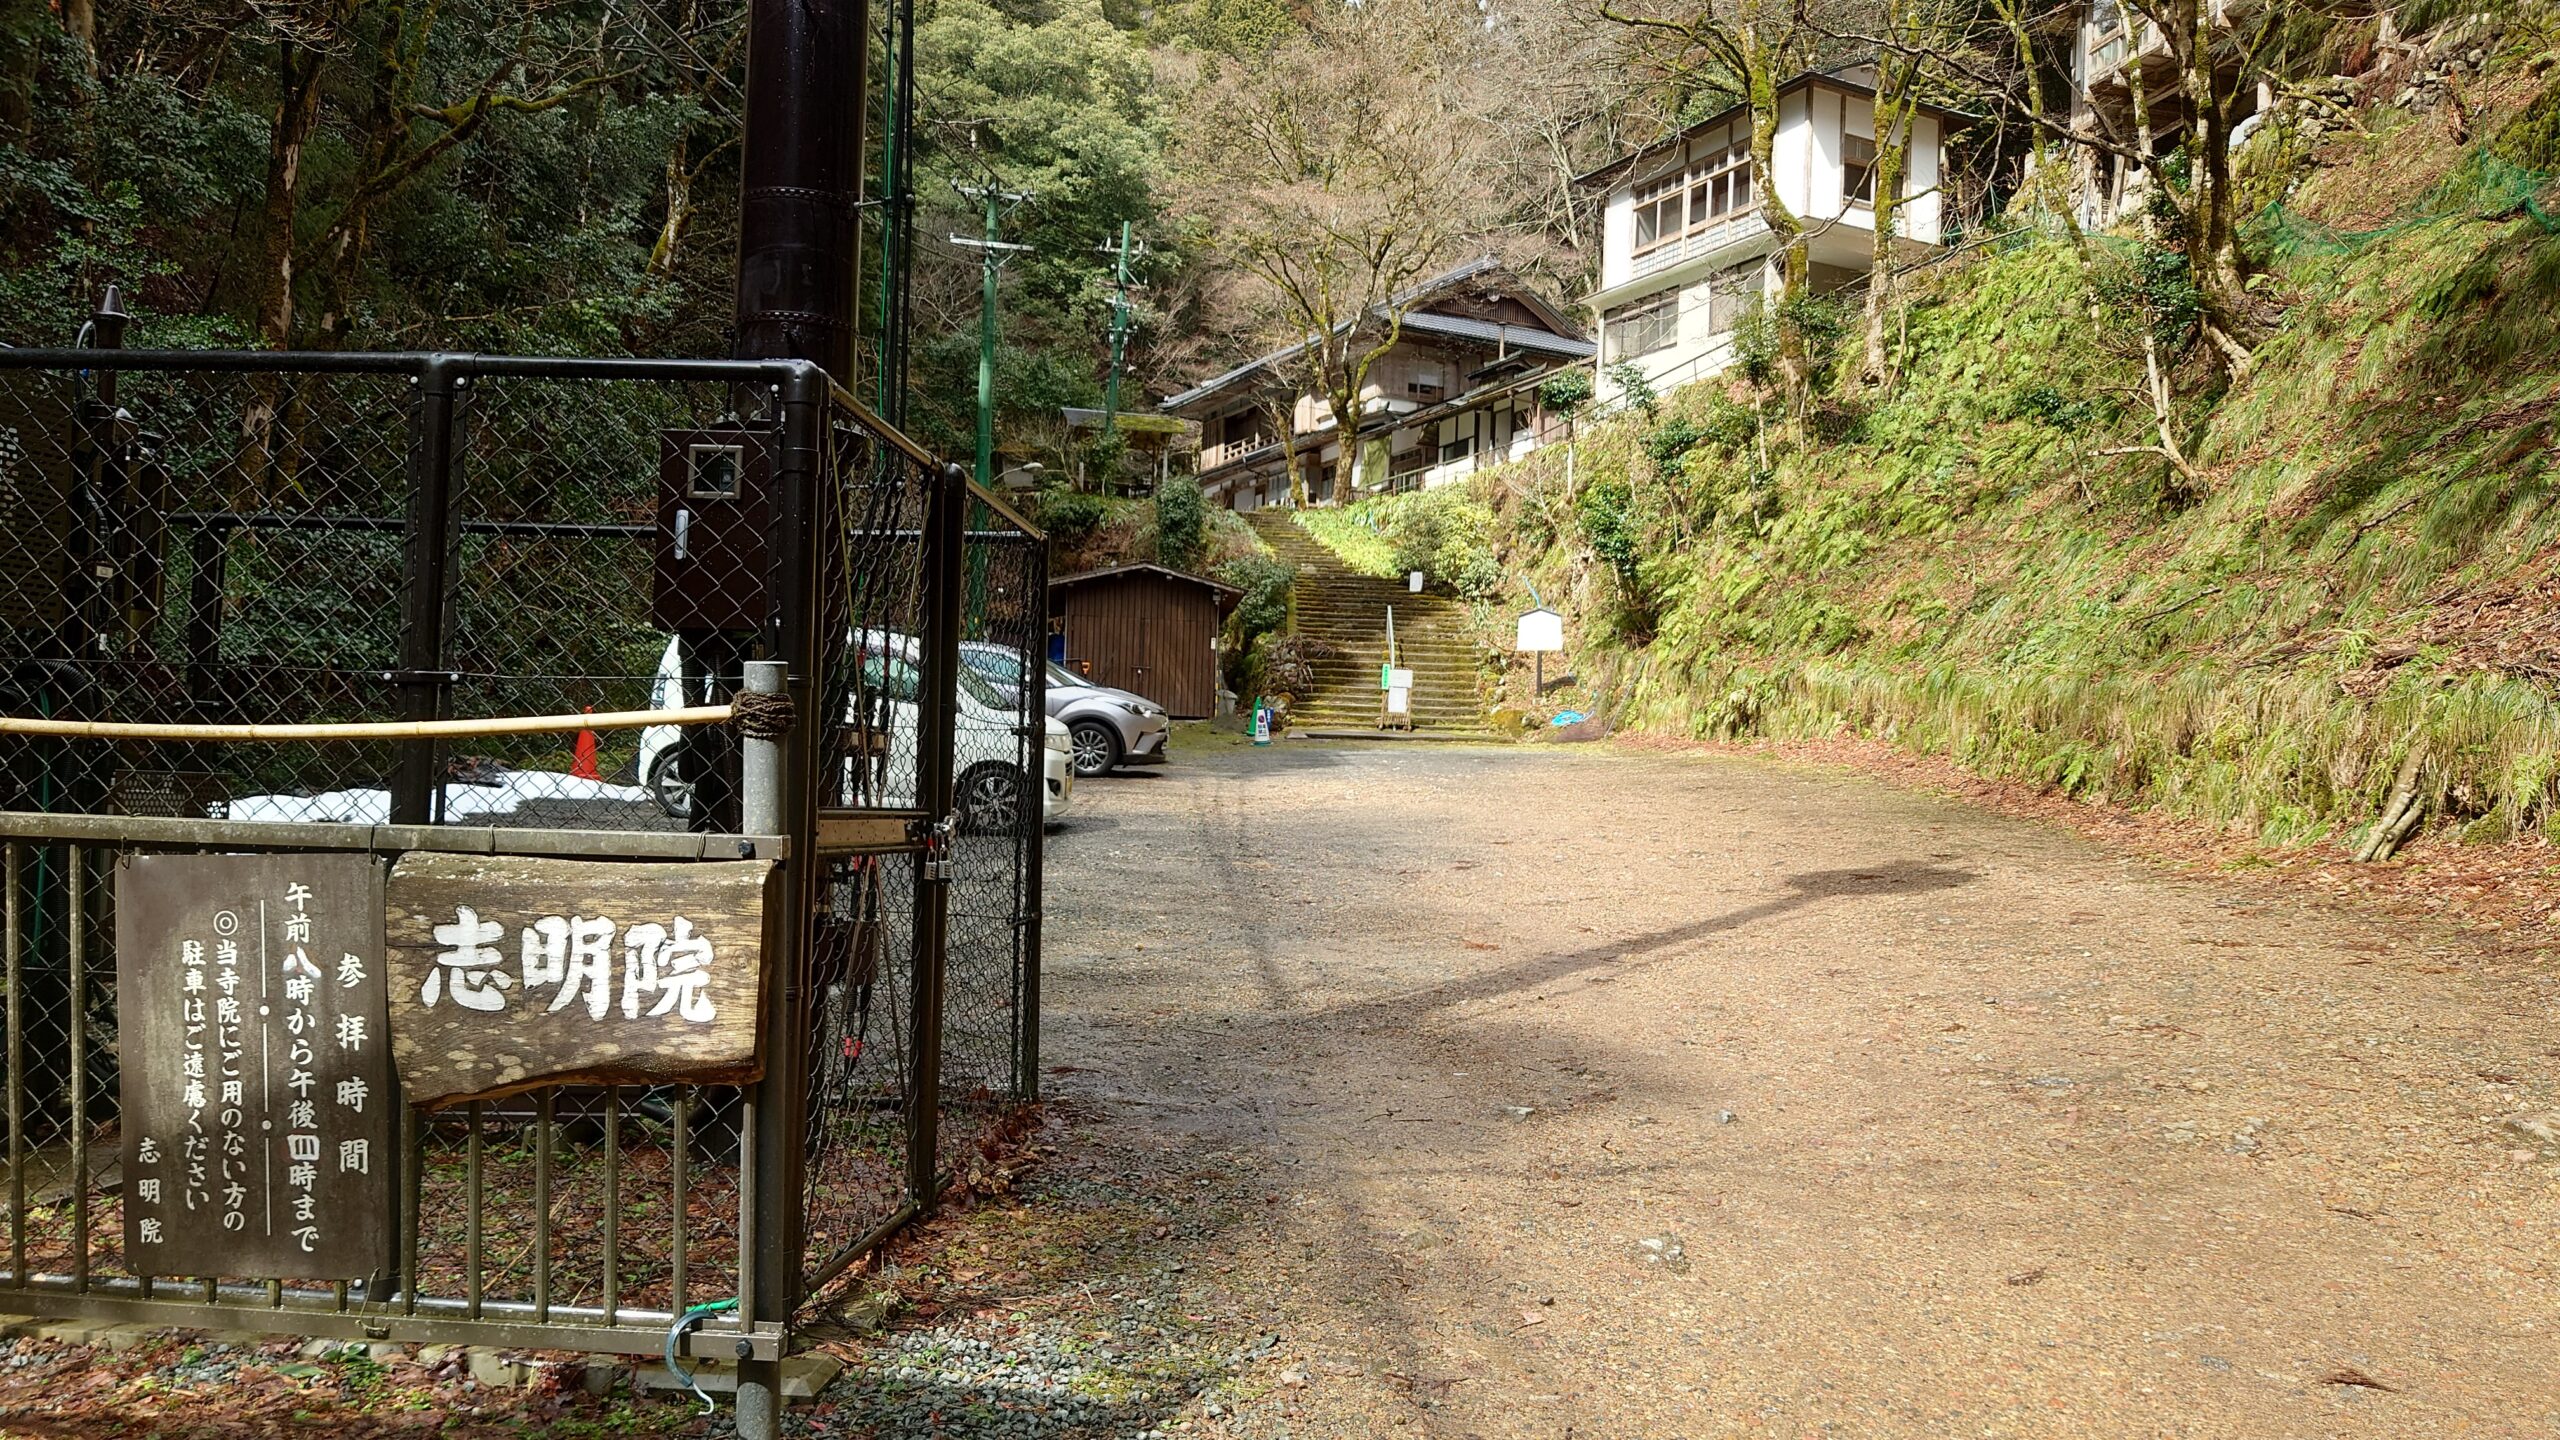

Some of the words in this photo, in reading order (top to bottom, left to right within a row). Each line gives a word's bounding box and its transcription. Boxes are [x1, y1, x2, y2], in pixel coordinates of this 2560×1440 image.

[283, 881, 322, 1252] 午前八時から午後四時まで
[336, 953, 370, 1175] 参拝時間
[421, 904, 717, 1023] 志明院
[181, 939, 210, 1211] 駐車はご遠慮ください
[138, 1137, 164, 1245] 志明院
